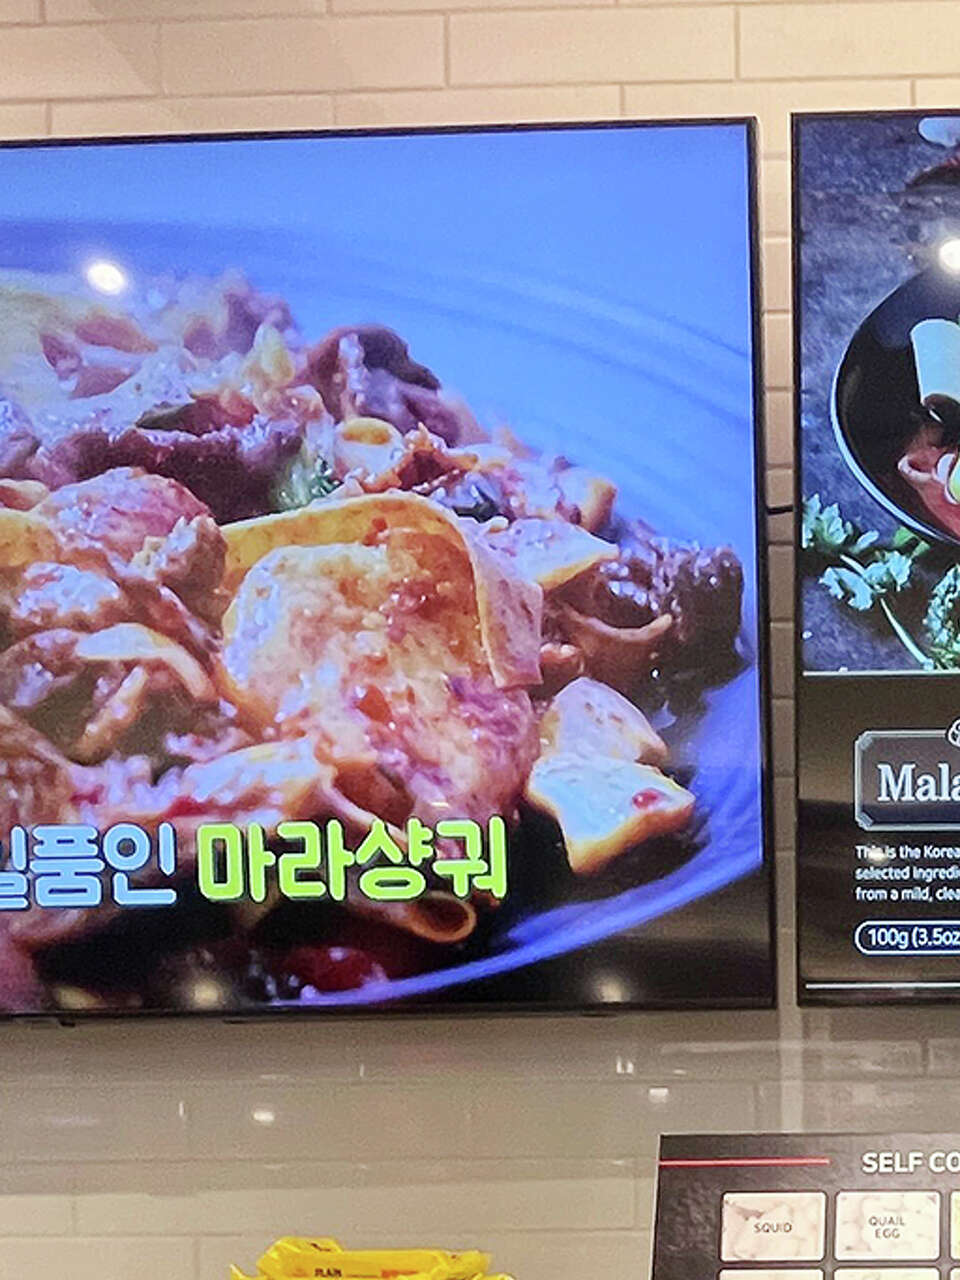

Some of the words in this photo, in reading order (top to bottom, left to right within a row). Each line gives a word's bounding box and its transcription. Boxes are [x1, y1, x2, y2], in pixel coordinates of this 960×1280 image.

[196, 816, 508, 902] 마라샹궈
[855, 844, 884, 860] Th
[900, 844, 921, 859] the
[855, 865, 910, 880] selected
[855, 886, 888, 901] from
[890, 889, 899, 901] a
[901, 886, 933, 902] mild,
[866, 927, 908, 951] 100g
[861, 1151, 924, 1174] SELF
[753, 1220, 793, 1235] SQUID
[868, 1215, 905, 1228] QUAIL
[874, 1227, 901, 1240] EGG
[314, 1268, 342, 1278] PLAIN
